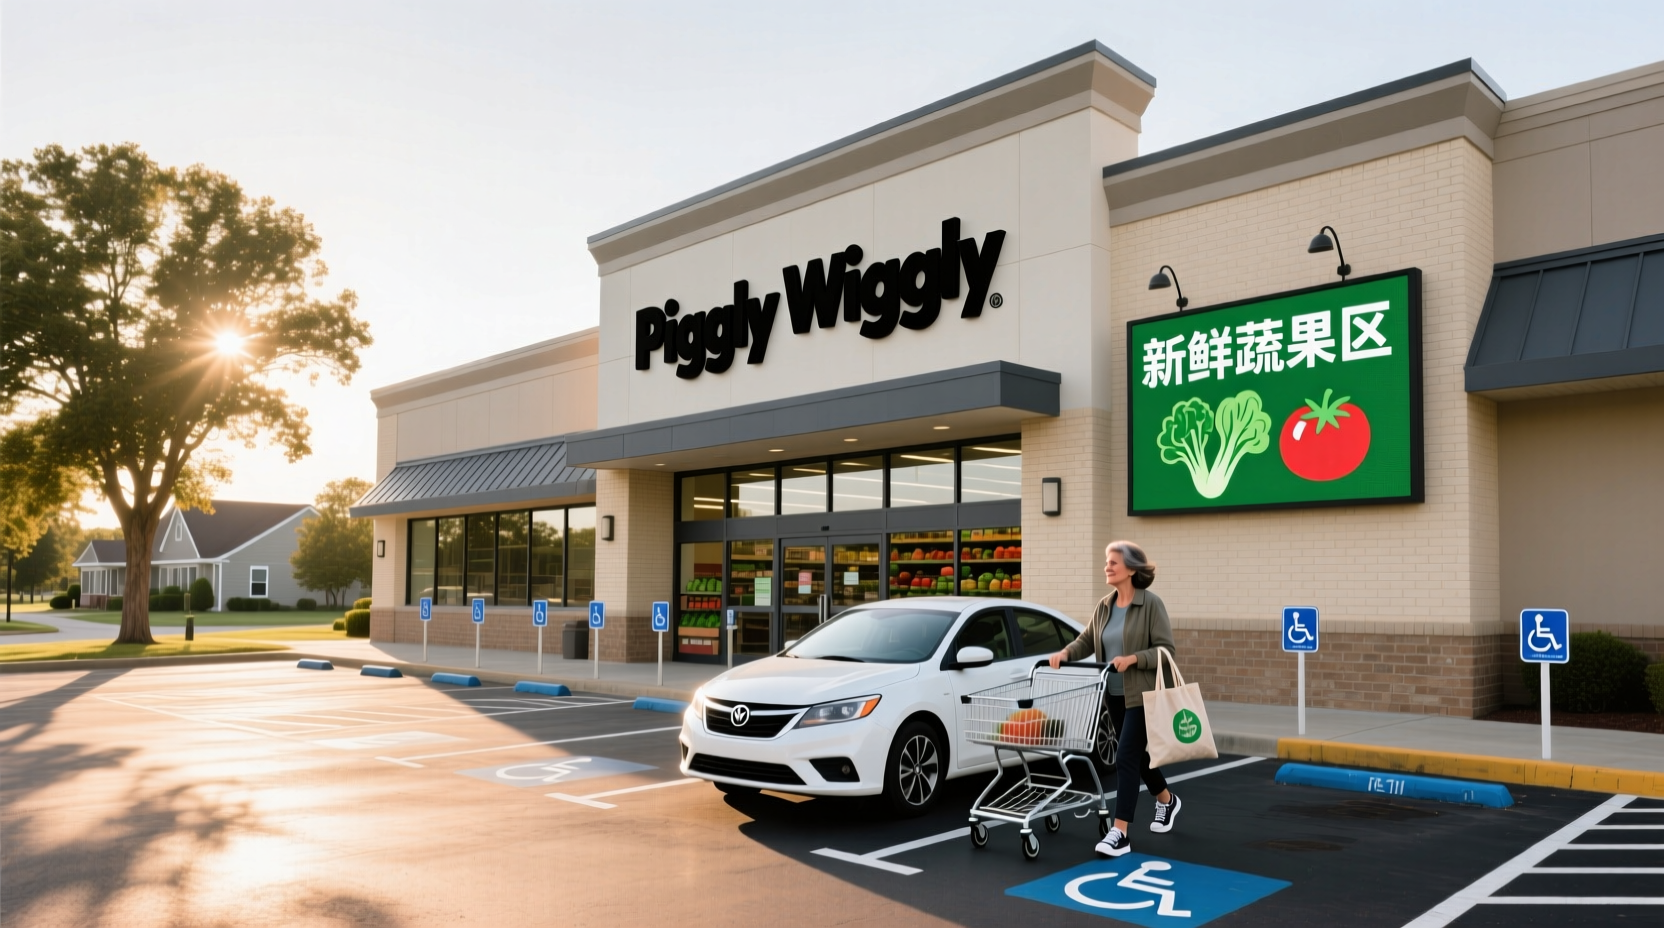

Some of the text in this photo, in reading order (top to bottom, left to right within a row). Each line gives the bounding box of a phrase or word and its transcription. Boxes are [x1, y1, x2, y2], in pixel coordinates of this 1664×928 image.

[636, 217, 1006, 380] Piggly Wiggly
[1141, 300, 1393, 389] 新鲜蔬果区
